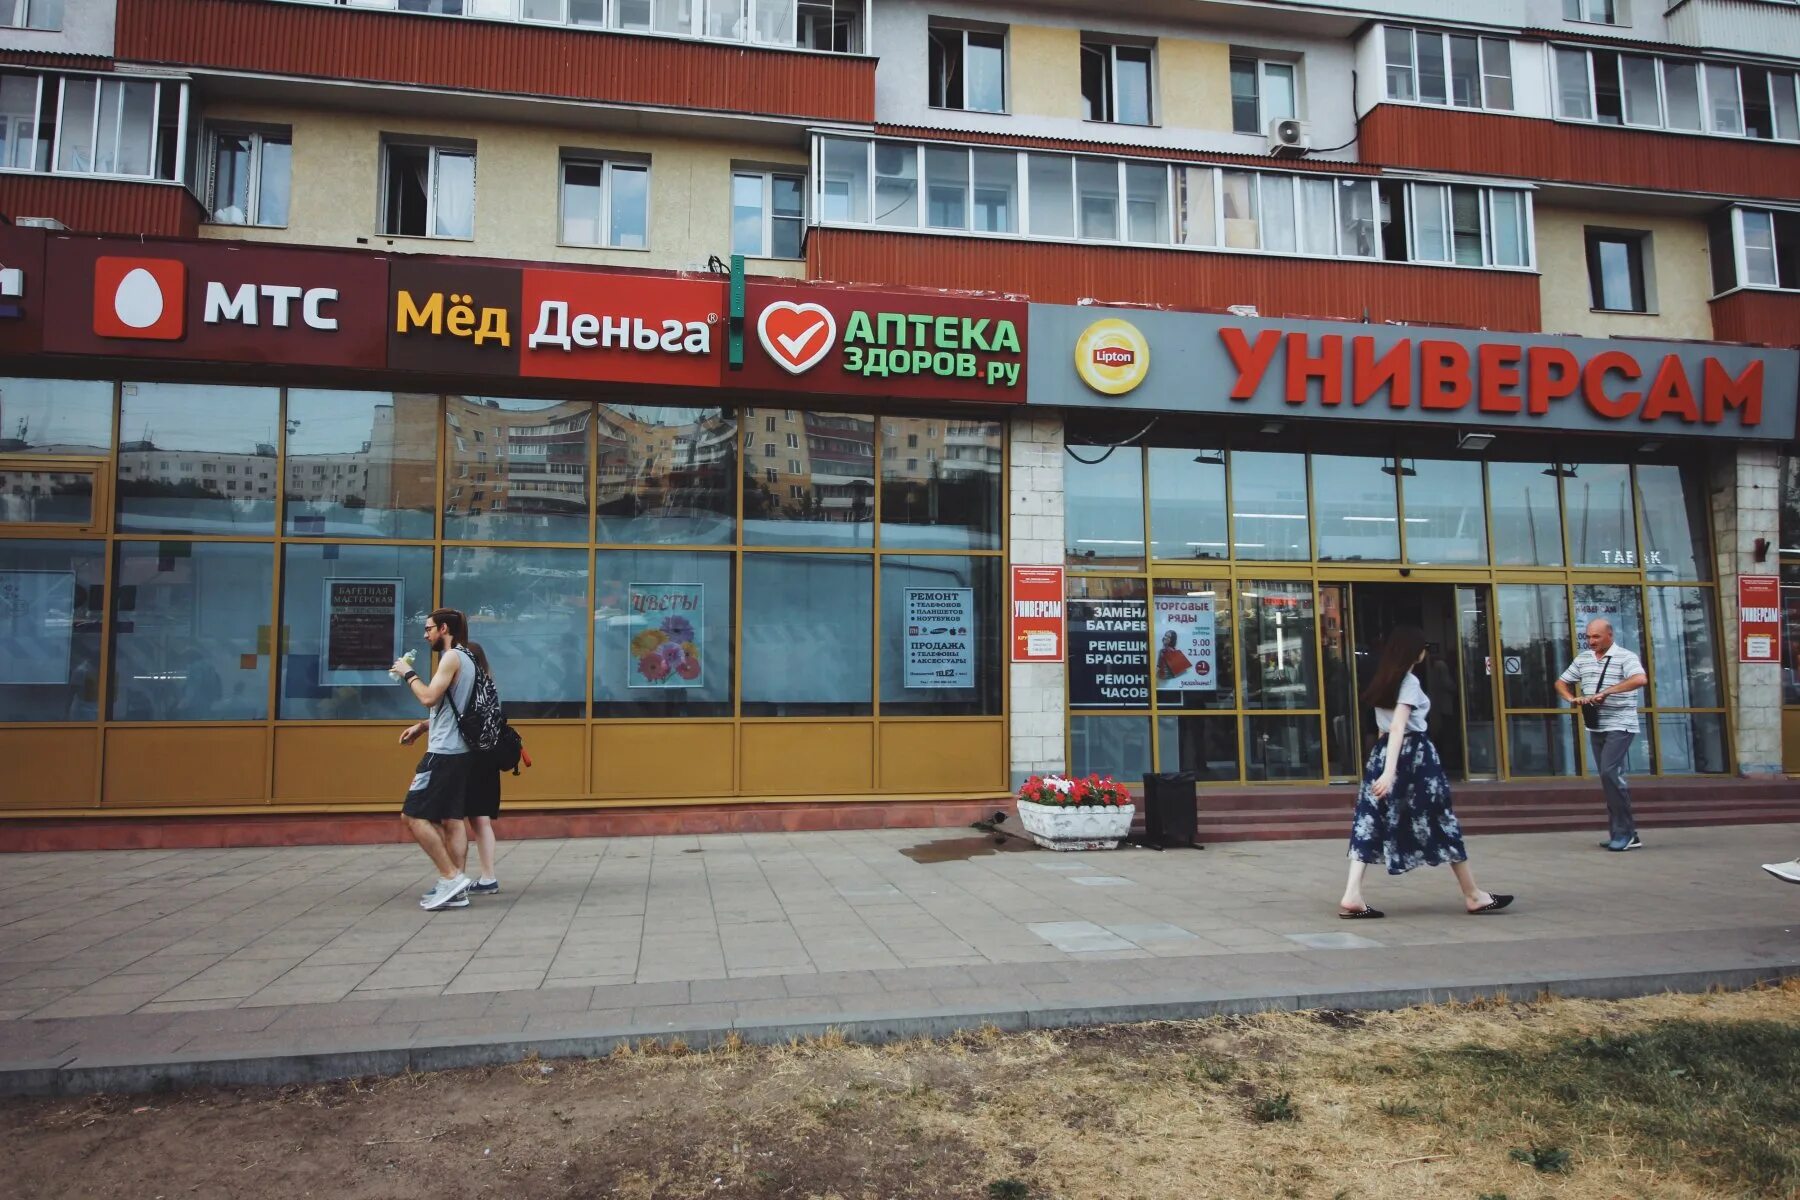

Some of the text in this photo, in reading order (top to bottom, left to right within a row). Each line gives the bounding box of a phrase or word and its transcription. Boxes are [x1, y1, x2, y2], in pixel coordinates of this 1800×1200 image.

[203, 281, 339, 331] МТС
[396, 290, 511, 347] Мёд
[528, 300, 711, 354] Деньга
[843, 310, 1021, 353] АПТЕКА
[1096, 351, 1131, 364] Lipton
[1218, 326, 1764, 425] УНИВЕРСАМ
[339, 587, 388, 596] БАГЕТНАЯ
[910, 592, 959, 601] РЕМОНТ
[334, 595, 393, 604] МАСТЕРСКАЯ
[632, 592, 699, 614] ЦВЕТЫ
[1014, 600, 1062, 618] УНИВЕРСАМ
[1155, 602, 1209, 611] ТОРГОВЫЕ
[1168, 614, 1197, 624] РЯДЫ
[1741, 607, 1778, 623] УНИВЕРСАМ
[911, 642, 965, 650] ПРОДАЖА
[1192, 638, 1210, 647] 9.00
[1187, 648, 1210, 657] 21.00
[1100, 687, 1149, 698] ЧАСОВ
